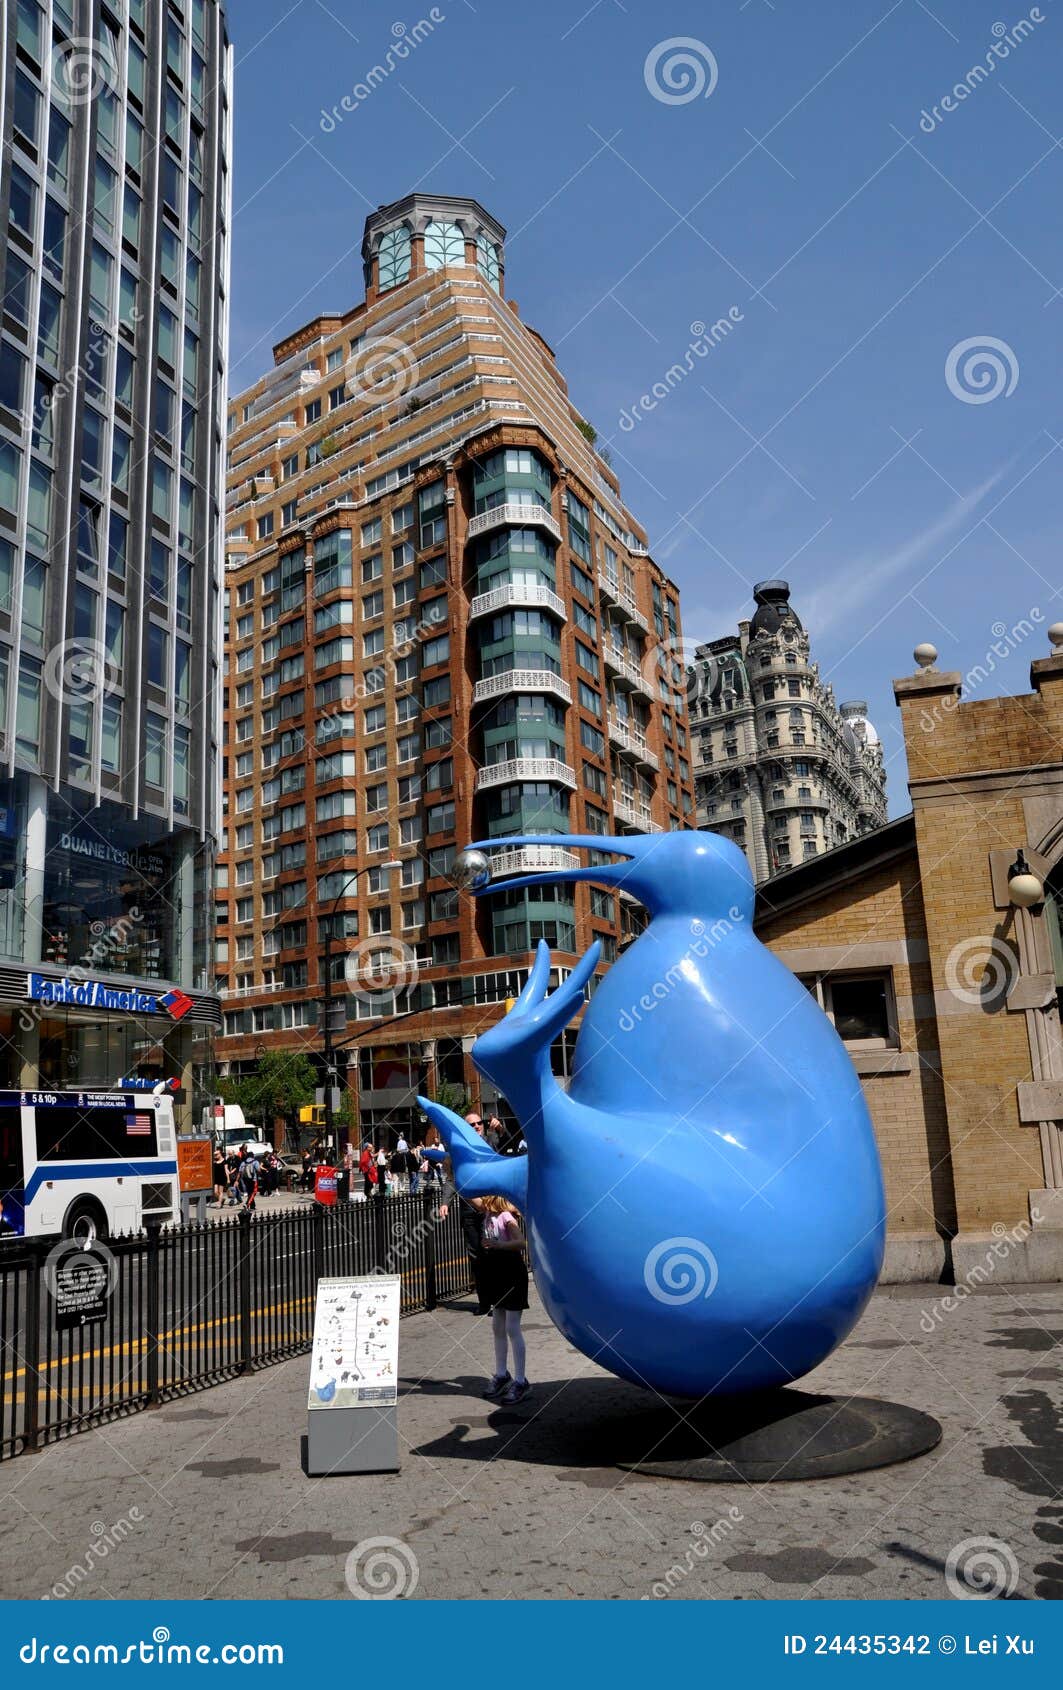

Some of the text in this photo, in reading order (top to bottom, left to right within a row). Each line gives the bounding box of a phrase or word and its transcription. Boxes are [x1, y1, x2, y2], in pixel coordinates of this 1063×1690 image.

[27, 973, 157, 1013] Bank of America
[32, 1094, 57, 1105] 5 & 10p
